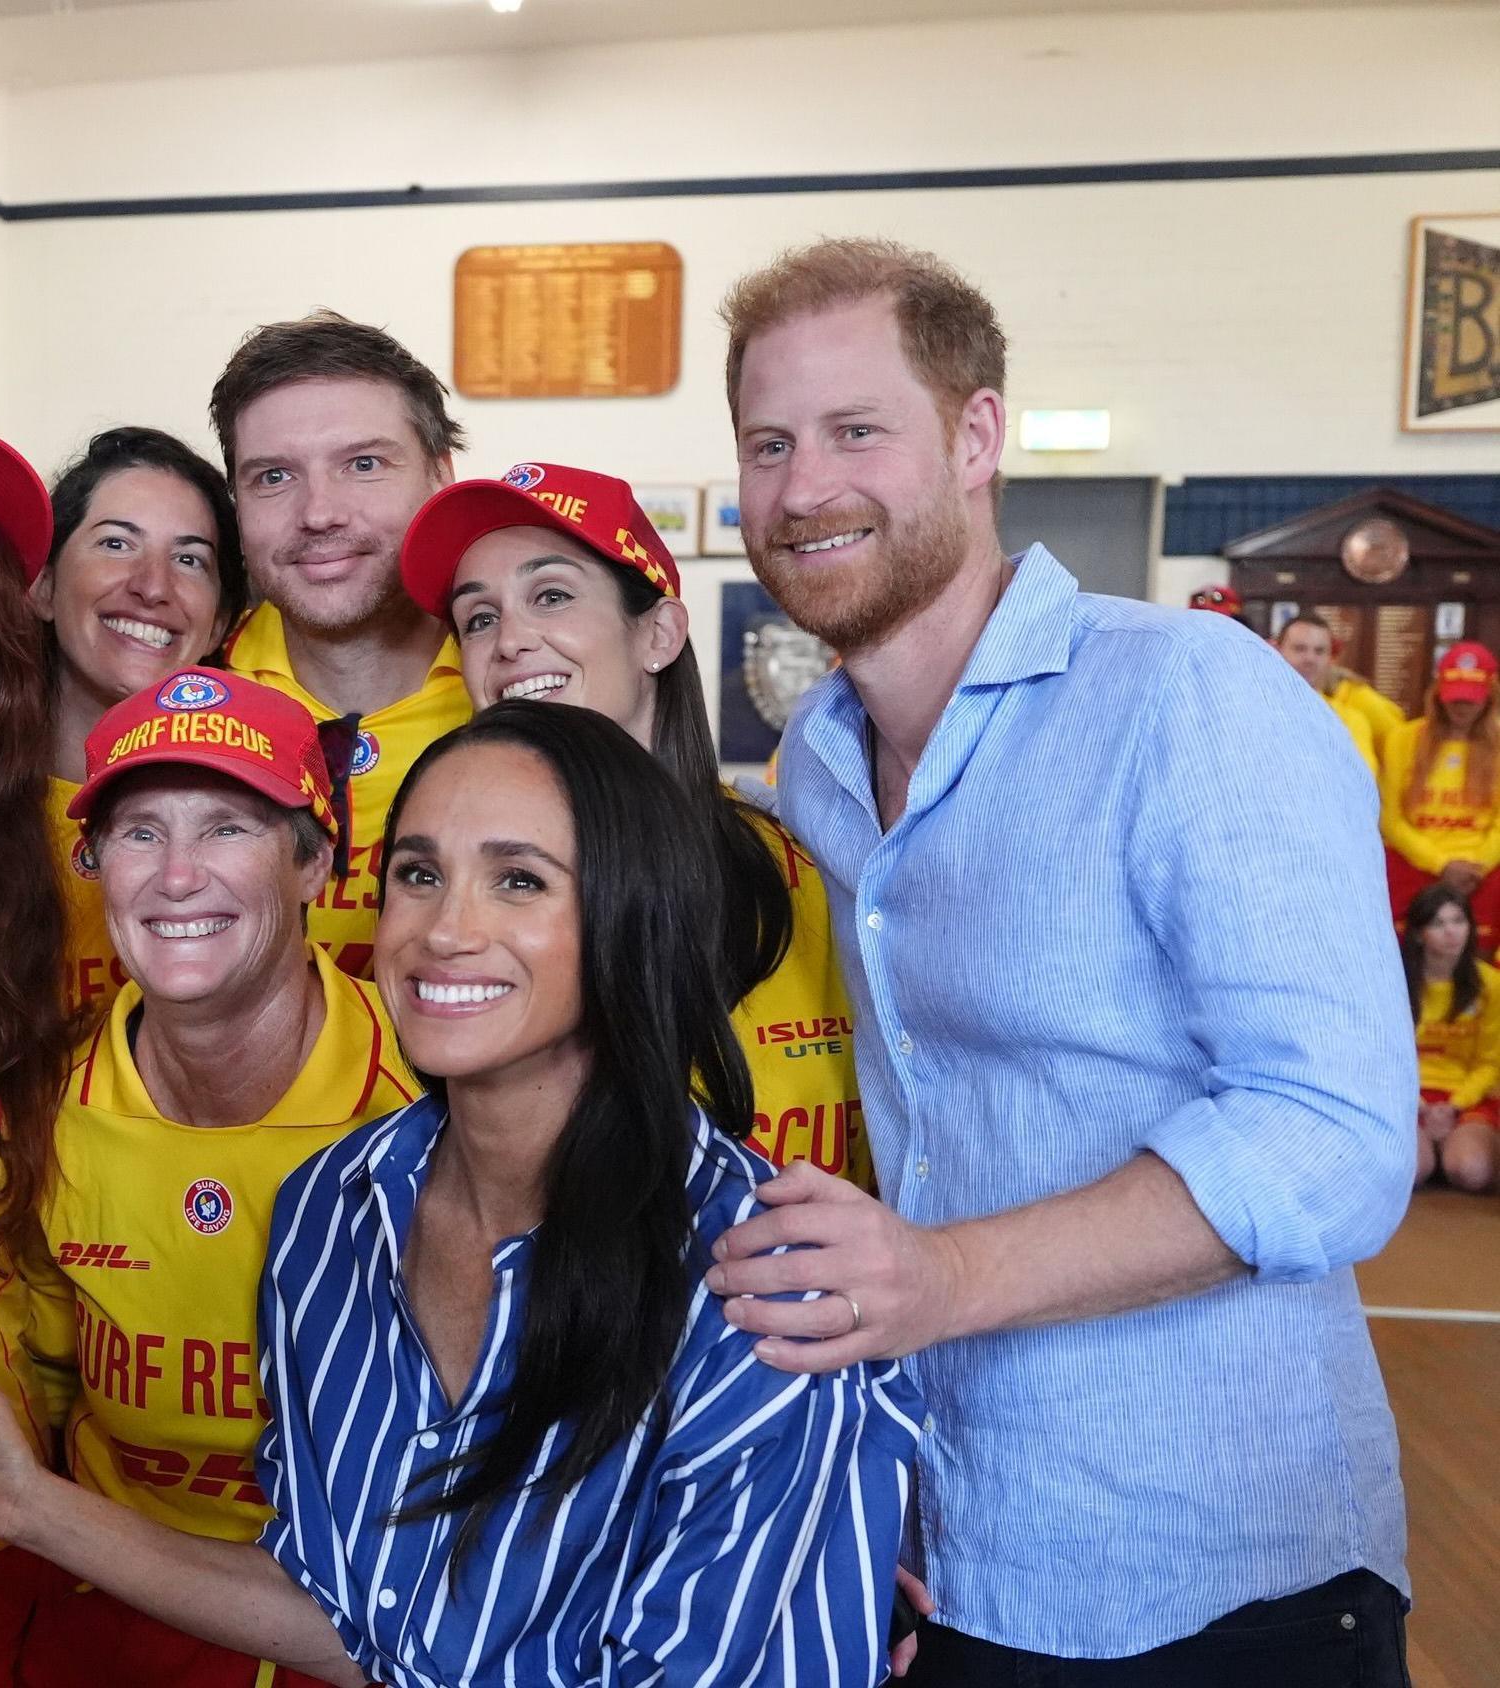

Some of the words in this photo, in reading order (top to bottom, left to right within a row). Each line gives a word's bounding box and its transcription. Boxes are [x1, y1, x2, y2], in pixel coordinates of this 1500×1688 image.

[177, 675, 216, 686] SURF
[181, 694, 224, 709] SAVING
[106, 716, 168, 765] SURF
[171, 712, 274, 761] RESCUE
[784, 1040, 842, 1058] UTE
[195, 1181, 221, 1190] SURF
[186, 1208, 201, 1228] LIFE
[202, 1209, 230, 1232] SAVING
[58, 1242, 134, 1270] DHL
[182, 1338, 272, 1421] RE
